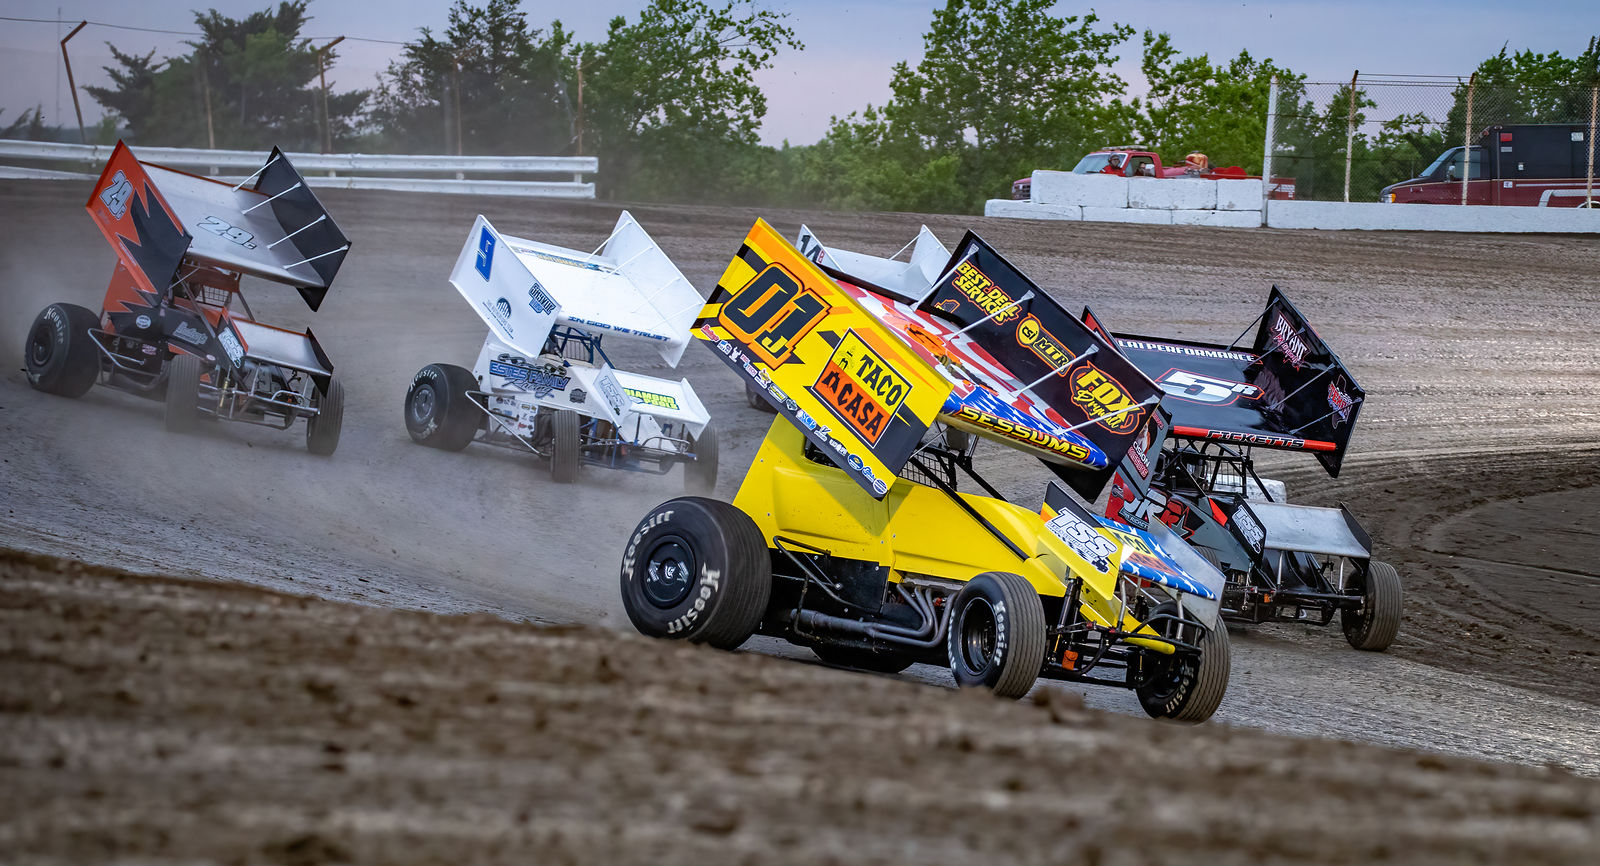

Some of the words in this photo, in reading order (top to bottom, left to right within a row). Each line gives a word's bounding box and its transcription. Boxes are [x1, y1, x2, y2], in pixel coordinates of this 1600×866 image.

[475, 225, 497, 282] 9
[956, 262, 992, 290] BEST
[954, 275, 1009, 322] SERVICES
[568, 315, 585, 325] IN
[586, 319, 612, 330] GOD
[613, 325, 632, 335] WE
[633, 329, 671, 342] TRUST
[1275, 314, 1307, 360] BRYANT
[1034, 338, 1069, 367] MTR
[1149, 343, 1256, 362] PERFORMANCE
[489, 360, 529, 382] ESTES
[528, 368, 572, 392] FAMILY
[855, 353, 903, 407] TACO
[1076, 368, 1140, 423] FOX
[835, 383, 885, 437] CASA
[961, 406, 1089, 460] SESSUMS
[1206, 429, 1305, 450] RICKETTS
[1056, 507, 1118, 558] TSS
